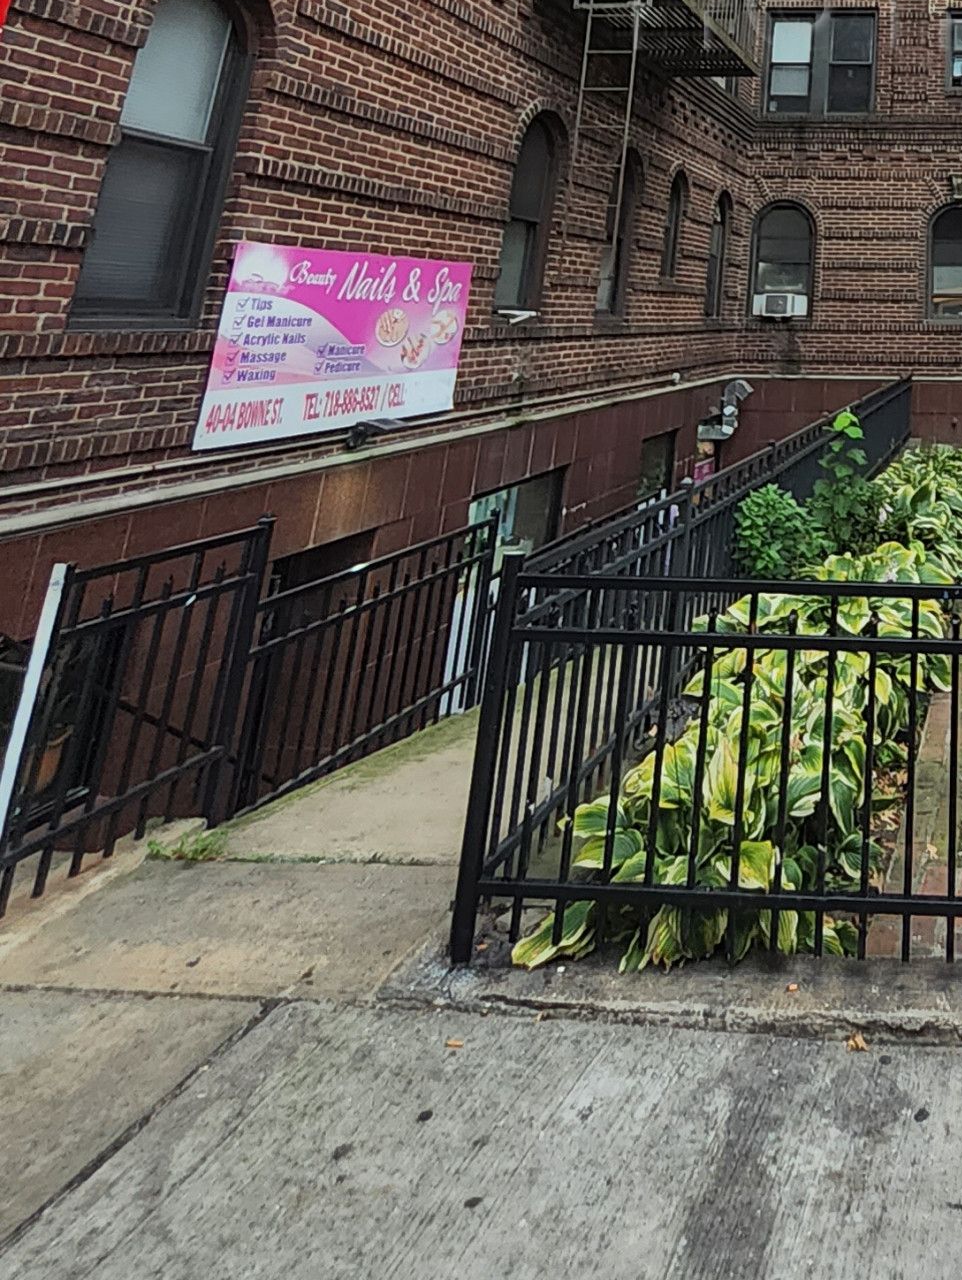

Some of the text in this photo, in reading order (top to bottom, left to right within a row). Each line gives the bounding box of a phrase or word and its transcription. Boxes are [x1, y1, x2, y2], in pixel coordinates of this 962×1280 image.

[290, 261, 463, 315] Beauty Nails & Spa
[251, 298, 273, 312] Tips
[247, 315, 312, 328] Gel Manicure
[243, 333, 306, 347] Acrylic Nails
[240, 351, 287, 364] Massage
[327, 344, 365, 357] Manicure
[324, 361, 361, 374] Pedicure
[236, 368, 276, 382] Waxing
[205, 403, 235, 434] 40-04
[235, 400, 272, 429] BOWNE
